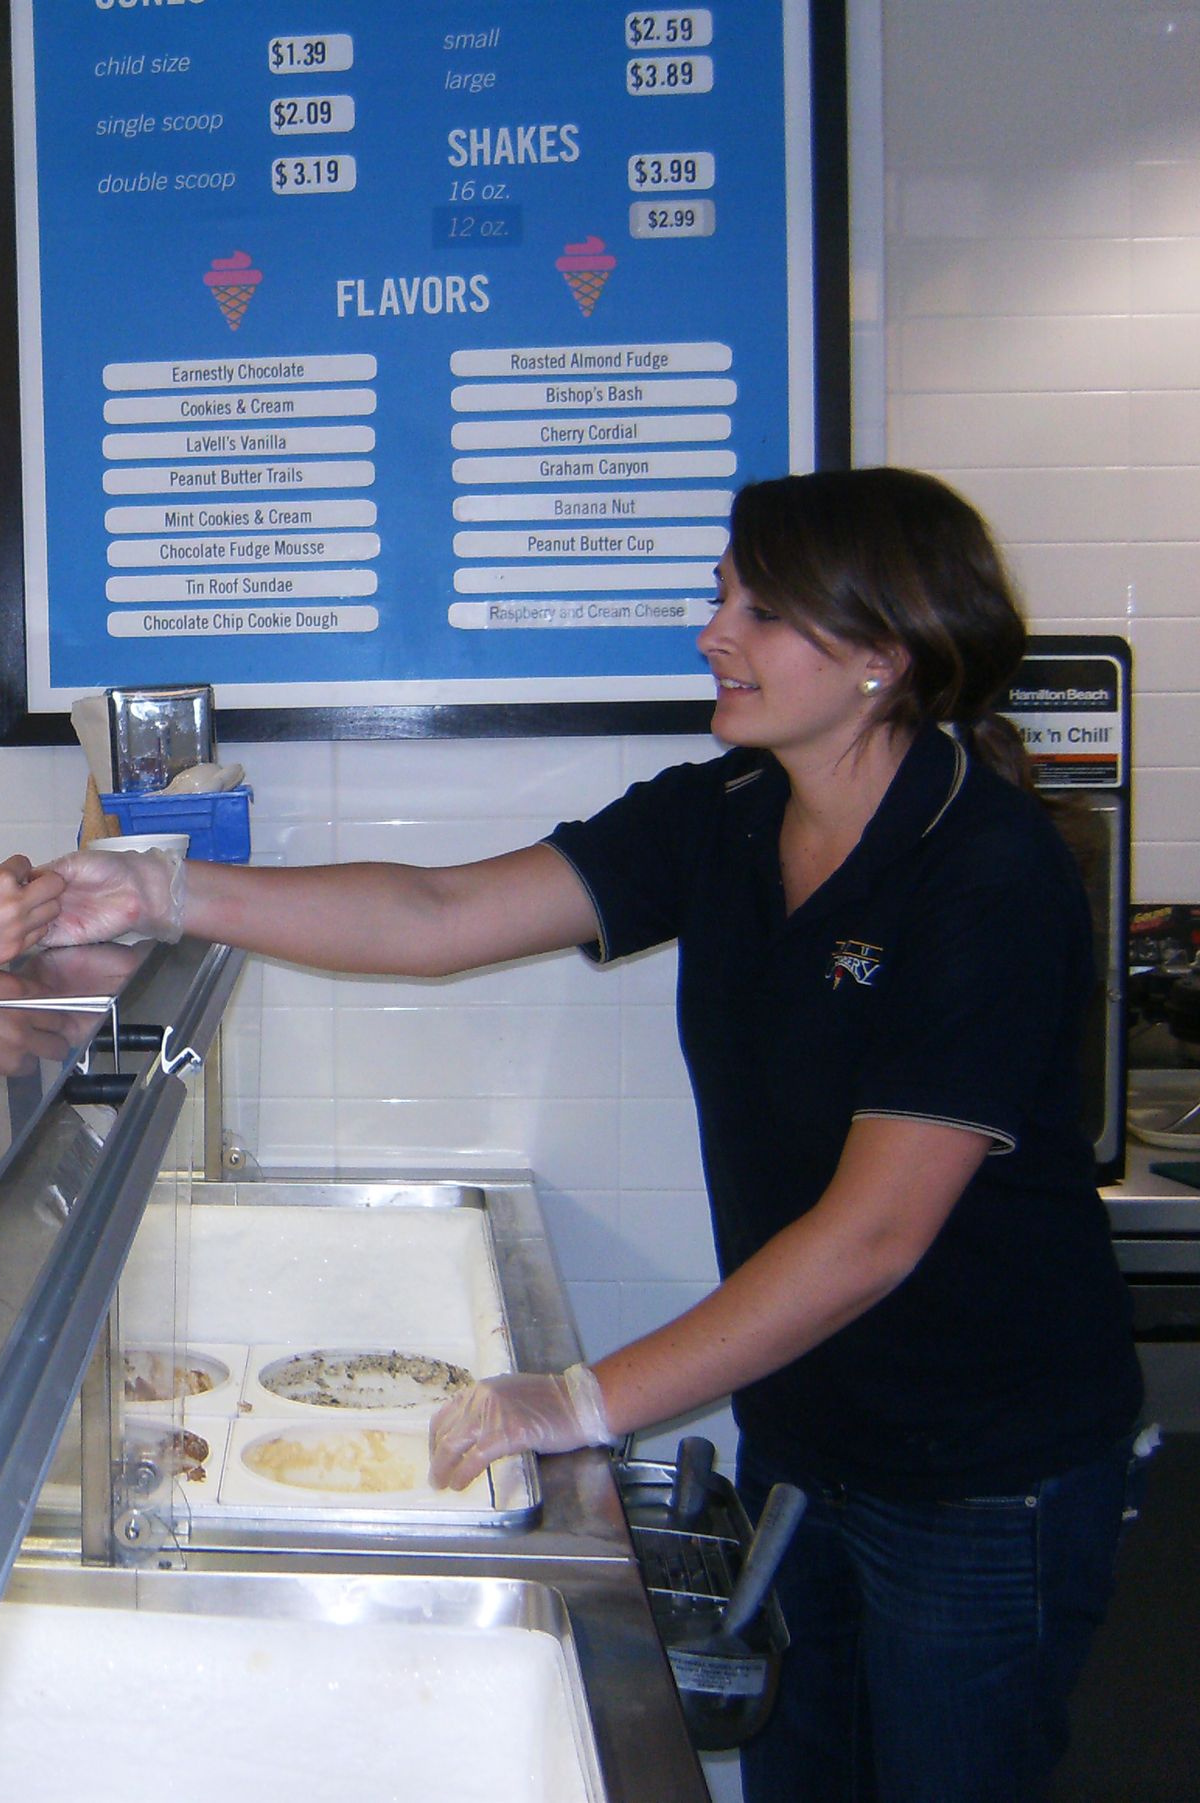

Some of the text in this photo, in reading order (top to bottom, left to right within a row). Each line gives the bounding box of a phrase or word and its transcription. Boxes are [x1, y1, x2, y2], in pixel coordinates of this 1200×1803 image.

[443, 27, 500, 50] small
[629, 16, 693, 46] $2.59
[95, 53, 190, 76] child size
[272, 41, 326, 68] $1.39
[445, 71, 495, 93] large
[631, 62, 693, 91] $3.89
[96, 113, 223, 137] single scoop
[274, 101, 331, 129] $2.09
[448, 124, 580, 167] SHAKES
[98, 172, 235, 193] double scoop
[276, 160, 339, 188] $3.19
[635, 158, 696, 187] $3.99
[449, 181, 510, 201] 16 oz.
[449, 217, 509, 237] 12 oz.
[649, 209, 694, 229] $2.99
[337, 274, 490, 317] FLAVORS
[511, 352, 668, 369] Roasted Almond Fudge
[172, 363, 304, 383] Earnestly Chocolate
[546, 386, 642, 405] Bishop's Bash
[181, 399, 294, 416] Cookies & Cream
[187, 435, 286, 452] LaVell's Vanilla
[541, 424, 636, 444] Cherry Cordial
[170, 468, 303, 487] Peanut Butter Trails
[540, 459, 648, 477] Graham Canyon
[554, 499, 635, 515] Banana Nut
[165, 509, 312, 527] Mint Cookies & Cream
[160, 540, 324, 559] Chocolate Fudge Mousse
[528, 536, 654, 553] Peanut Butter Cup
[186, 577, 292, 595] Tin Roof Sundae
[144, 612, 338, 631] Chocolate Chip Cookie Dough
[490, 603, 684, 622] Raspberry and Cream Cheese
[1009, 688, 1109, 700] Hamilton Beach
[1046, 728, 1061, 743] 'n
[1068, 727, 1109, 743] Chill
